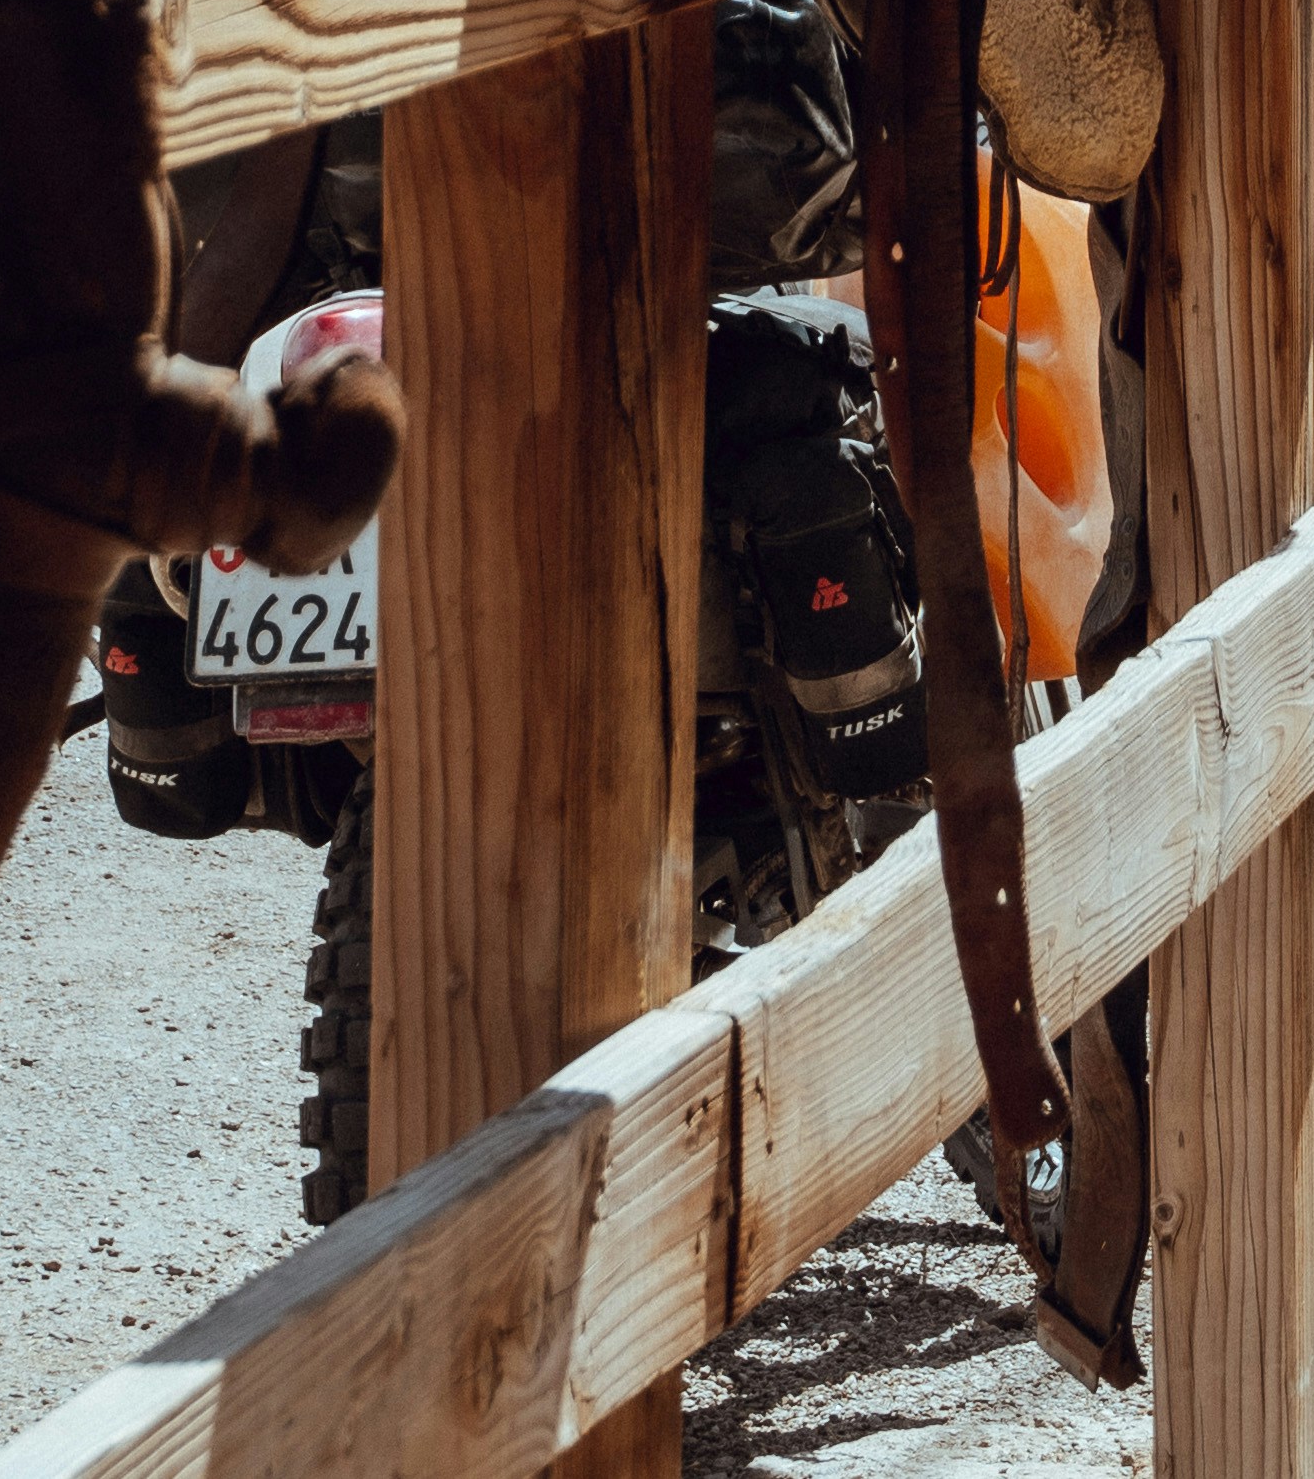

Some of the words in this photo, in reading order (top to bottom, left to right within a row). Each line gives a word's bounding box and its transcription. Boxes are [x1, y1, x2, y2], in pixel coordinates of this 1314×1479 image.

[201, 591, 371, 667] 4624
[826, 703, 904, 741] TUSK
[110, 756, 179, 787] TUSK
